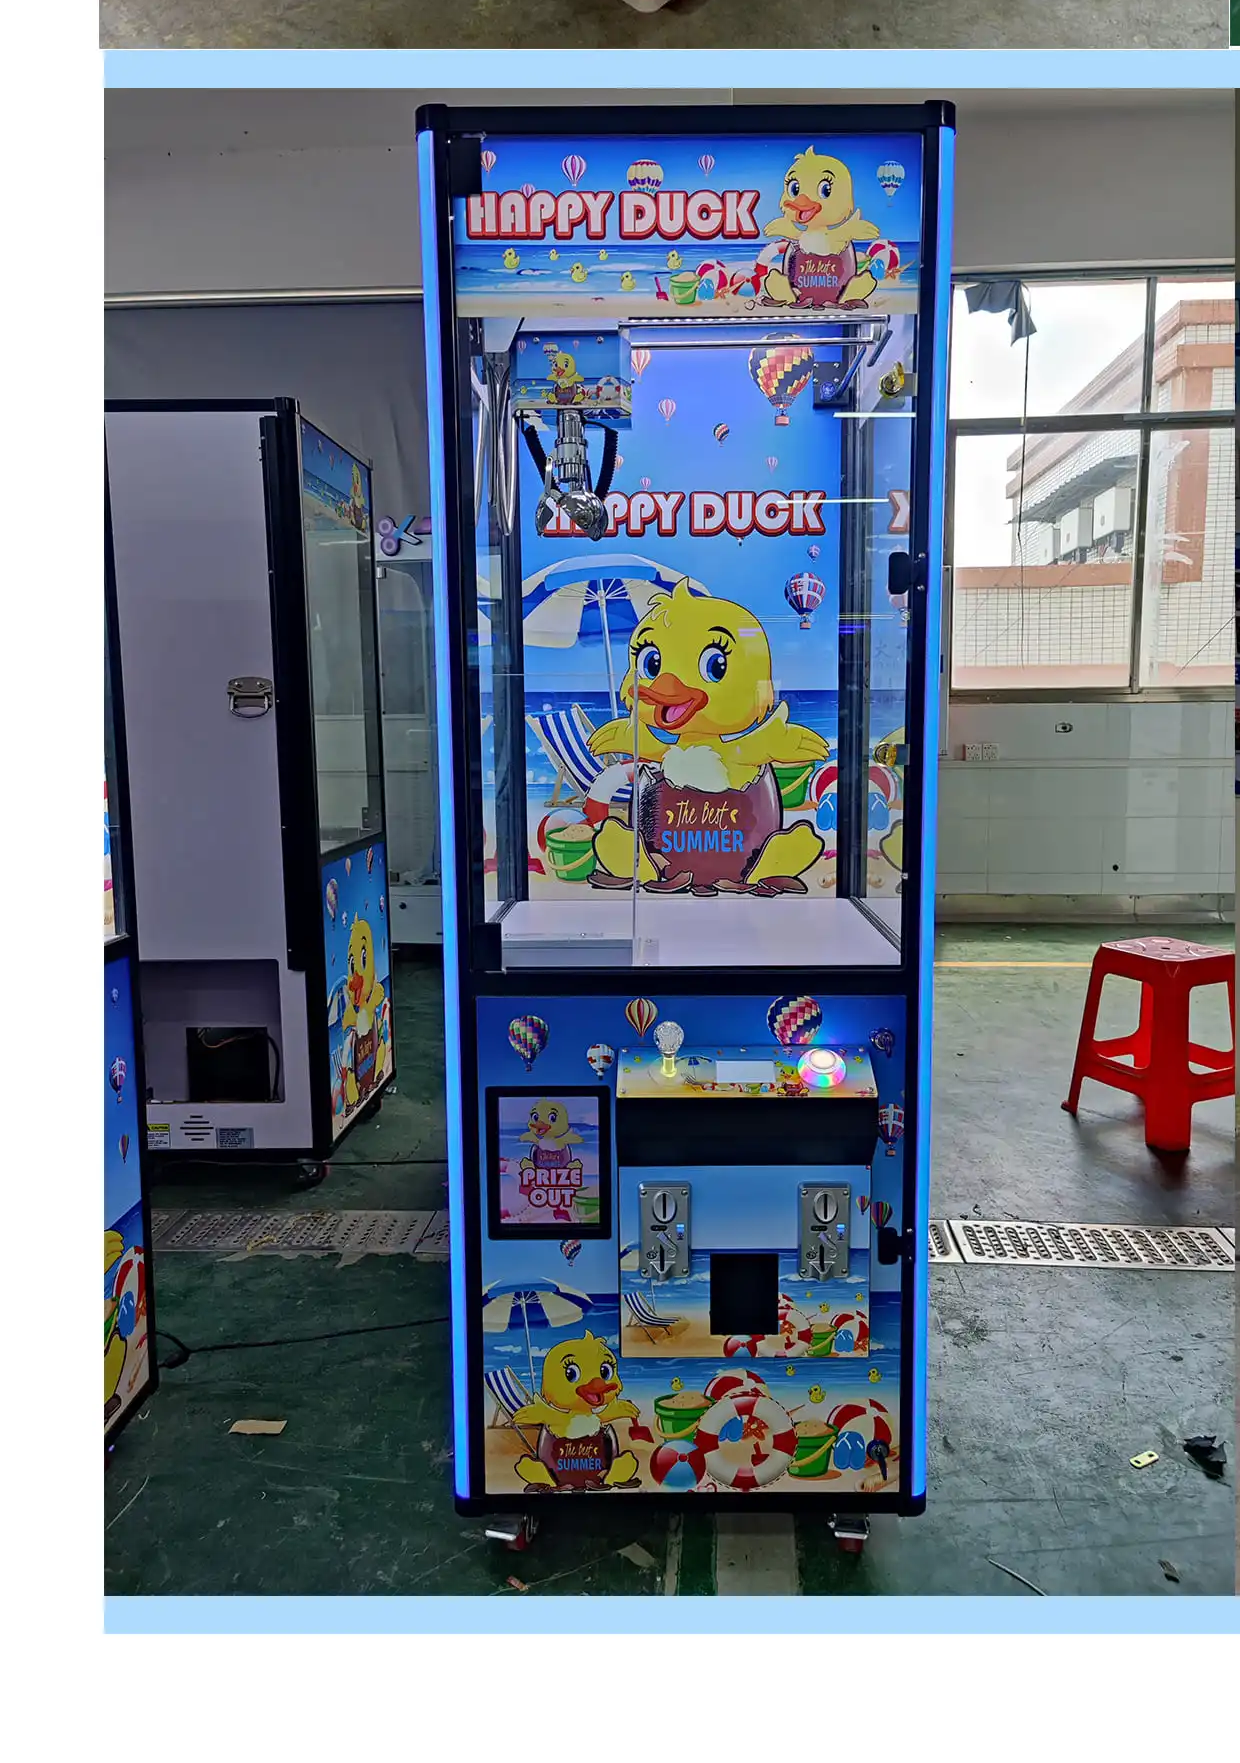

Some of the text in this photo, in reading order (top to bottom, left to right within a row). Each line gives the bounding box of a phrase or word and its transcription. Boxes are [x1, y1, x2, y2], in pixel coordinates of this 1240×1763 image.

[466, 190, 760, 240] HAPPY DUCK
[798, 275, 838, 288] SUMMER
[690, 490, 826, 536] DUCK
[676, 799, 698, 827] The
[661, 830, 745, 853] SUMMER
[521, 1167, 582, 1187] PRIZE
[528, 1187, 577, 1208] OUT
[557, 1458, 601, 1471] SUMMER
